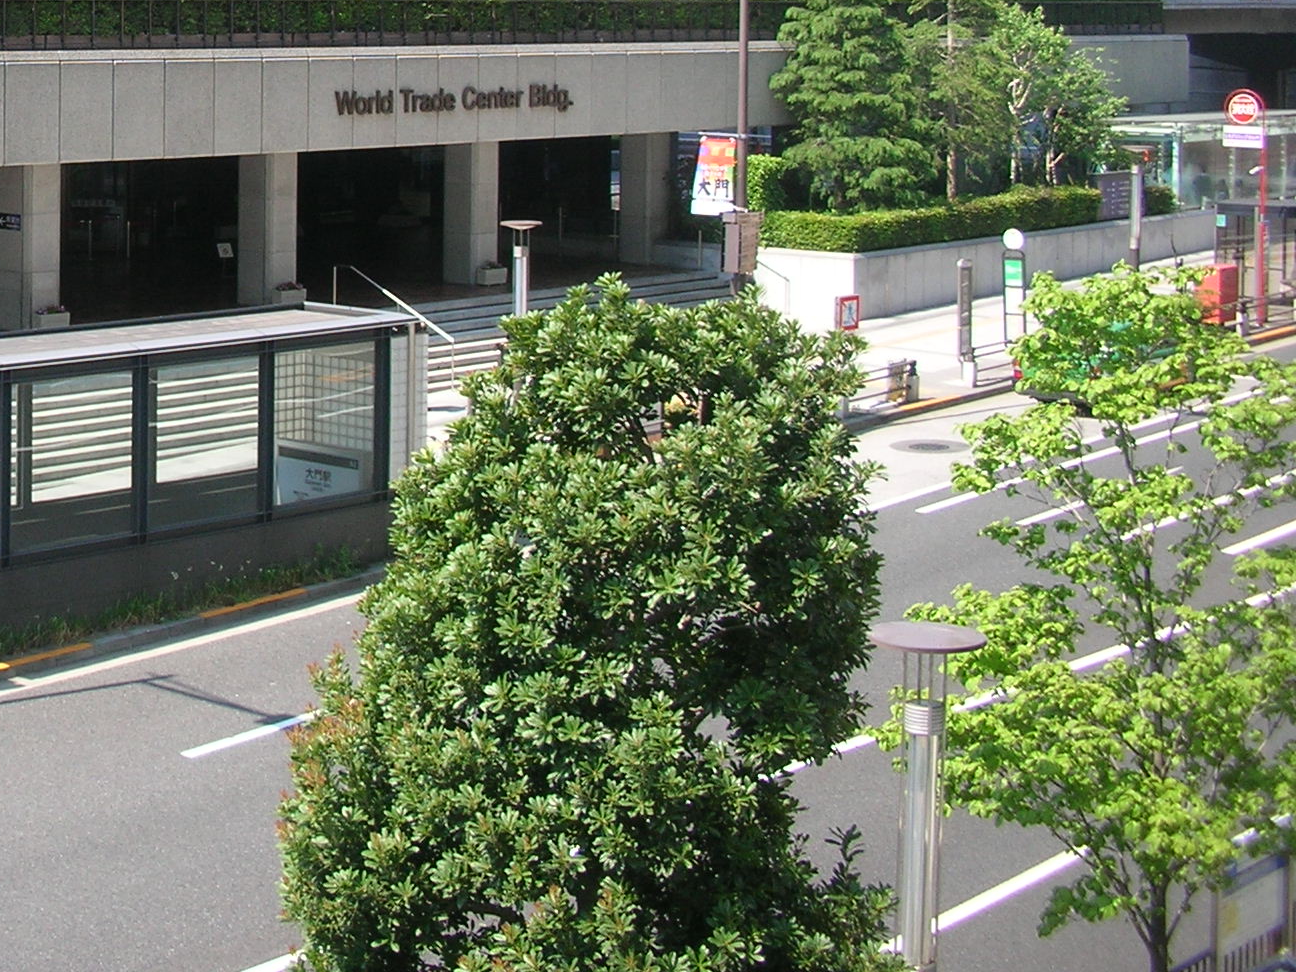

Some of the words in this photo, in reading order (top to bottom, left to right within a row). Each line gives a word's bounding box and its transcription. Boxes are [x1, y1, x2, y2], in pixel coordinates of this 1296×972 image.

[334, 88, 394, 116] World
[399, 87, 456, 113] Trade
[461, 85, 524, 111] Center
[528, 82, 574, 112] Bldg.
[697, 178, 730, 198] 大門
[305, 468, 332, 482] 大門駅
